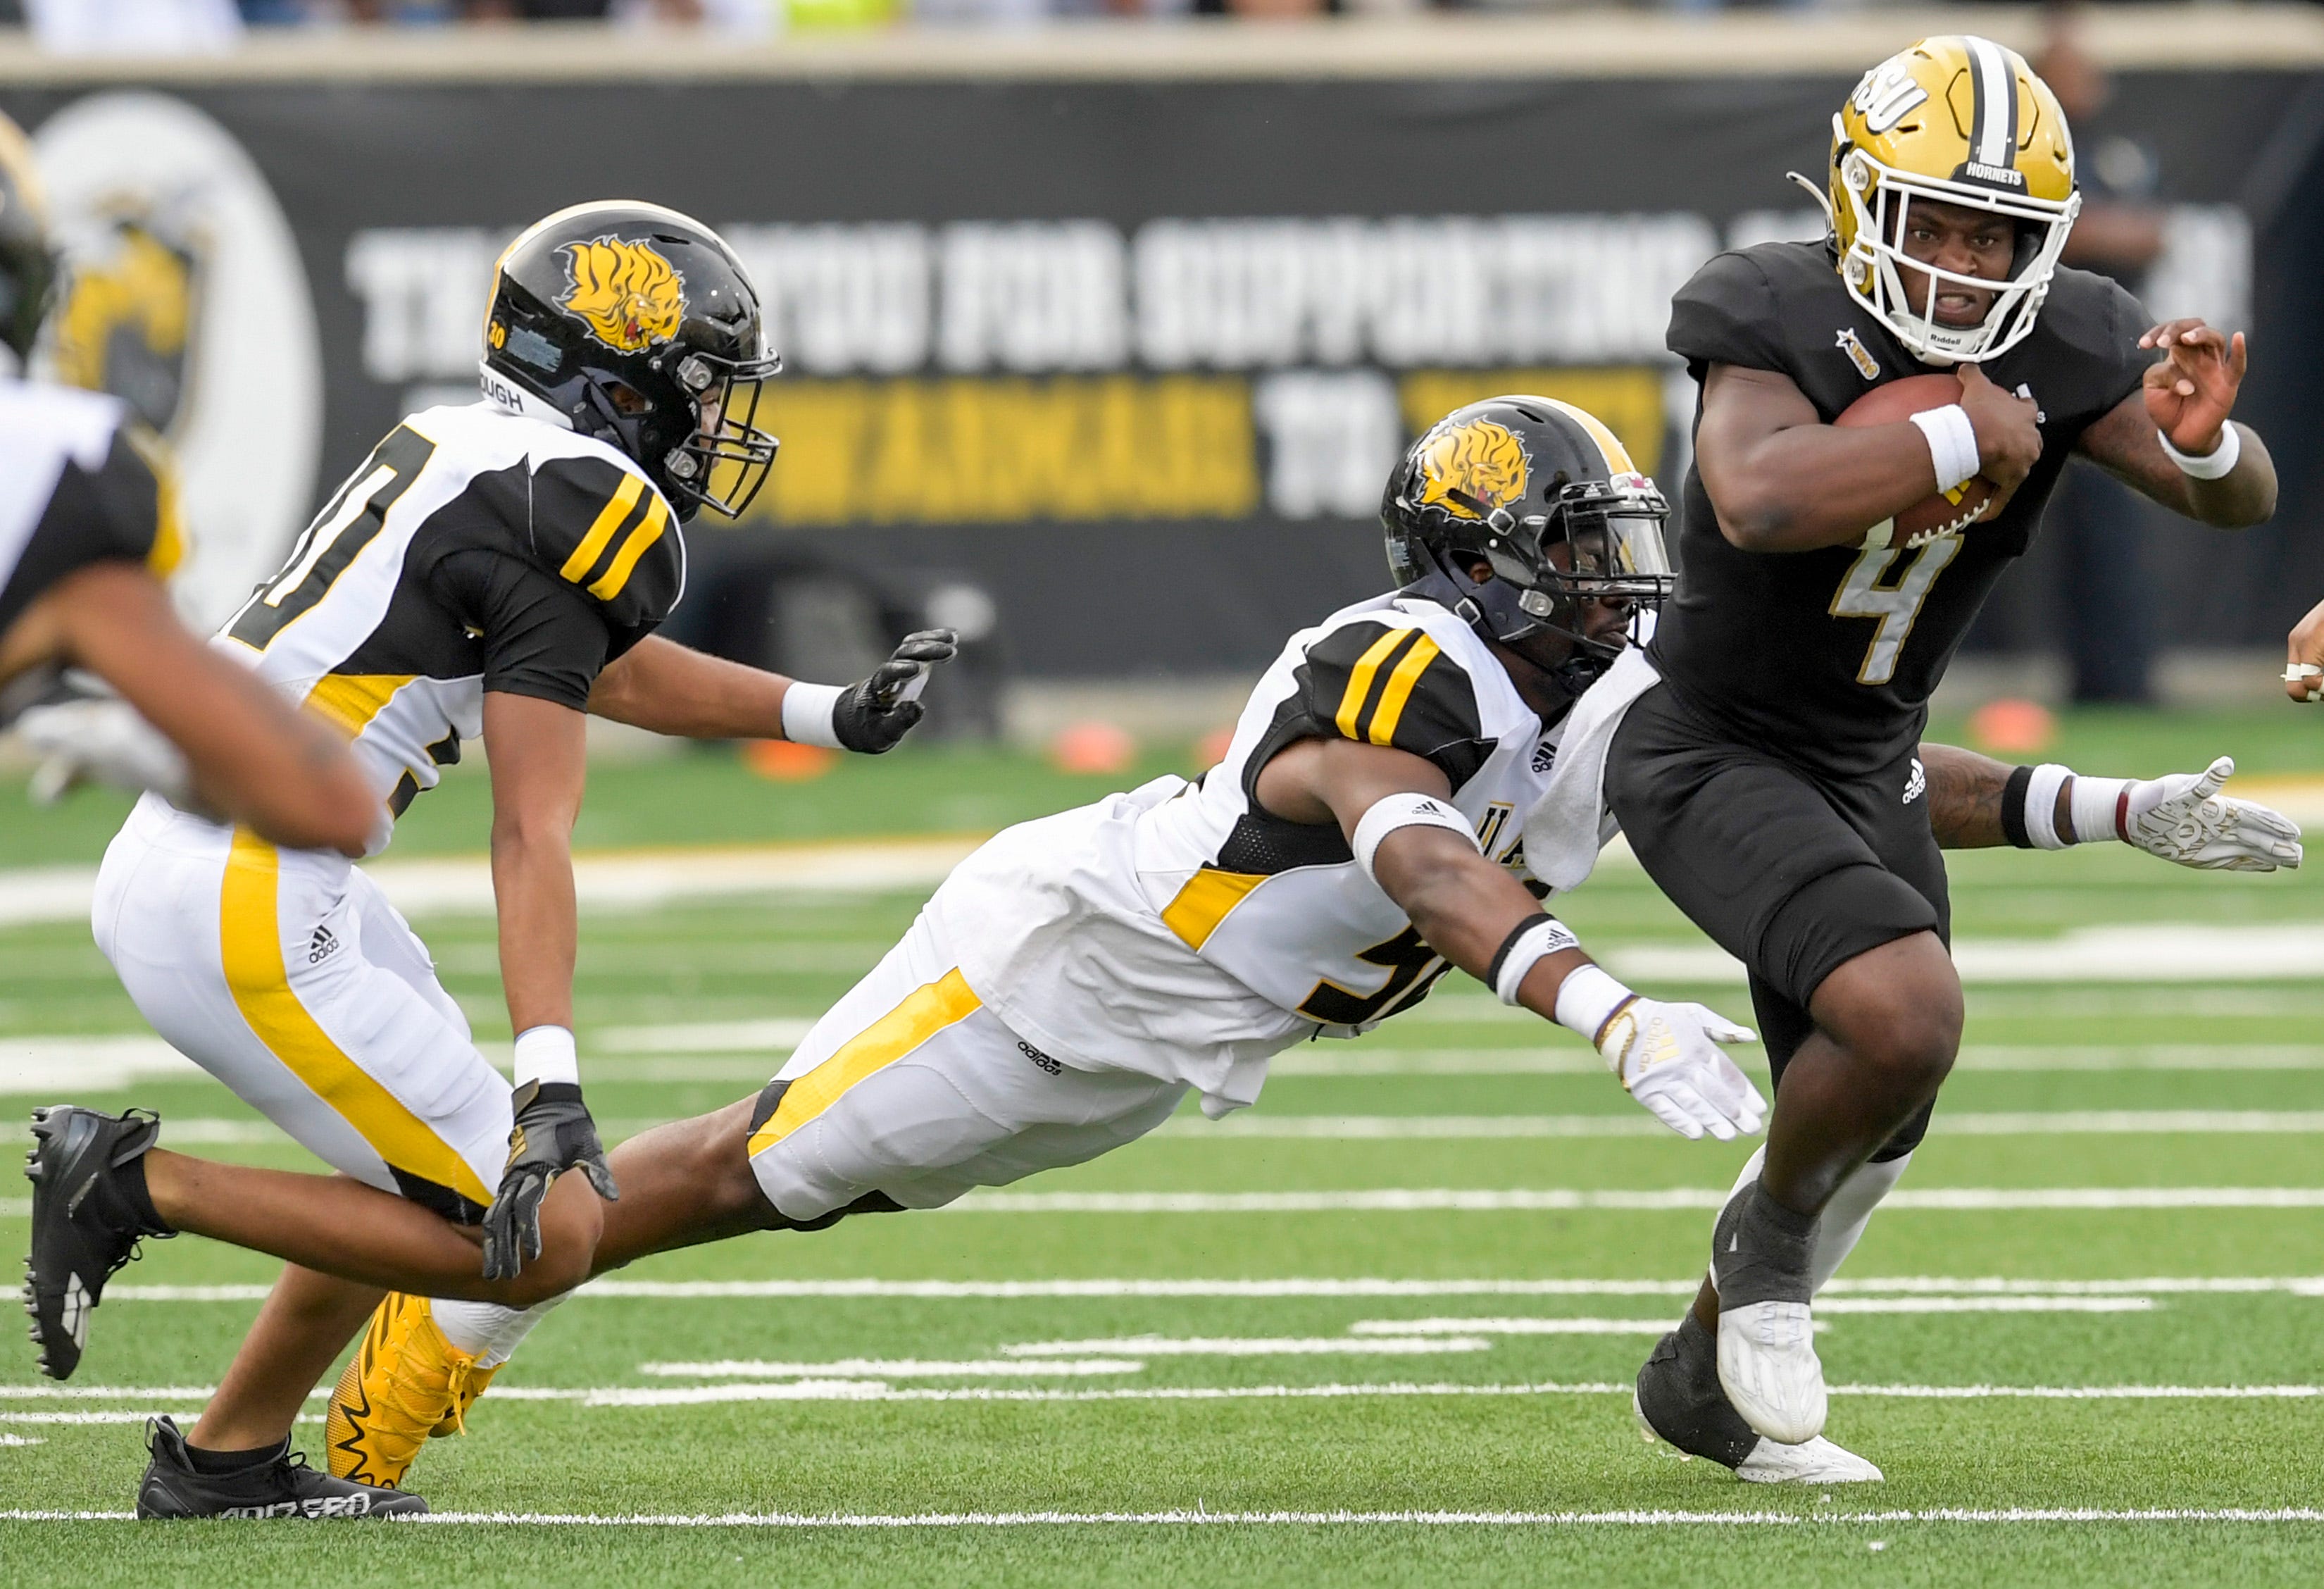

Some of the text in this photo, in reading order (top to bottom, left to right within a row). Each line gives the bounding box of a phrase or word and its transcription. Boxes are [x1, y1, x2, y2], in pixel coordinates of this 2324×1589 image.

[1966, 161, 2022, 186] HORNETS
[488, 320, 506, 349] 30
[1930, 333, 1961, 345] Riddell
[1828, 533, 1965, 685] 4
[1018, 1041, 1062, 1076] adidas
